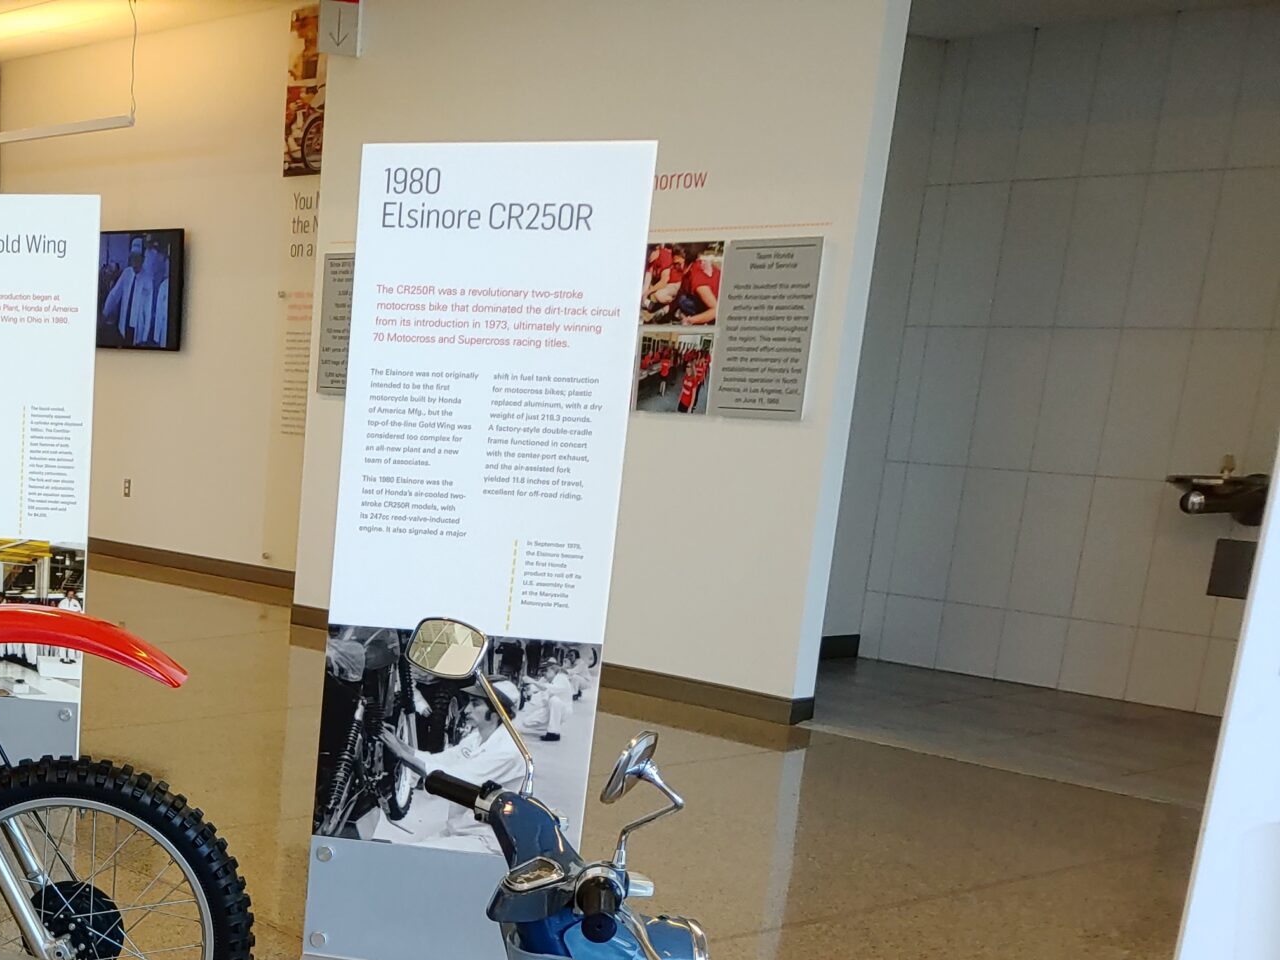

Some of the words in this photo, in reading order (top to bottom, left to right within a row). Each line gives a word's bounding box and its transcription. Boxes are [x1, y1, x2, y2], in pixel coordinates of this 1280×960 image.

[384, 167, 441, 195] 1980
[654, 171, 708, 191] orrow
[293, 191, 313, 210] You
[291, 215, 310, 234] the
[381, 201, 482, 230] Elsinore
[488, 202, 594, 231] CR250R
[25, 234, 67, 259] Wing
[290, 243, 303, 258] on
[377, 284, 394, 294] The
[396, 285, 435, 295] CR250R
[438, 288, 458, 296] was
[459, 288, 466, 296] a
[468, 288, 529, 298] revolutionary
[376, 302, 426, 311] motocross
[428, 302, 448, 312] bike
[451, 303, 469, 312] that
[472, 304, 524, 314] dominated
[526, 305, 542, 315] the
[590, 308, 620, 317] circuit
[375, 316, 397, 326] from
[400, 318, 411, 327] its
[414, 319, 470, 328] introduction
[513, 321, 561, 332] ultimately
[563, 324, 602, 335] winning
[373, 332, 385, 342] 70
[387, 333, 436, 343] Motocross
[438, 335, 456, 344] and
[457, 334, 510, 346] Supercross
[512, 339, 542, 349] racing
